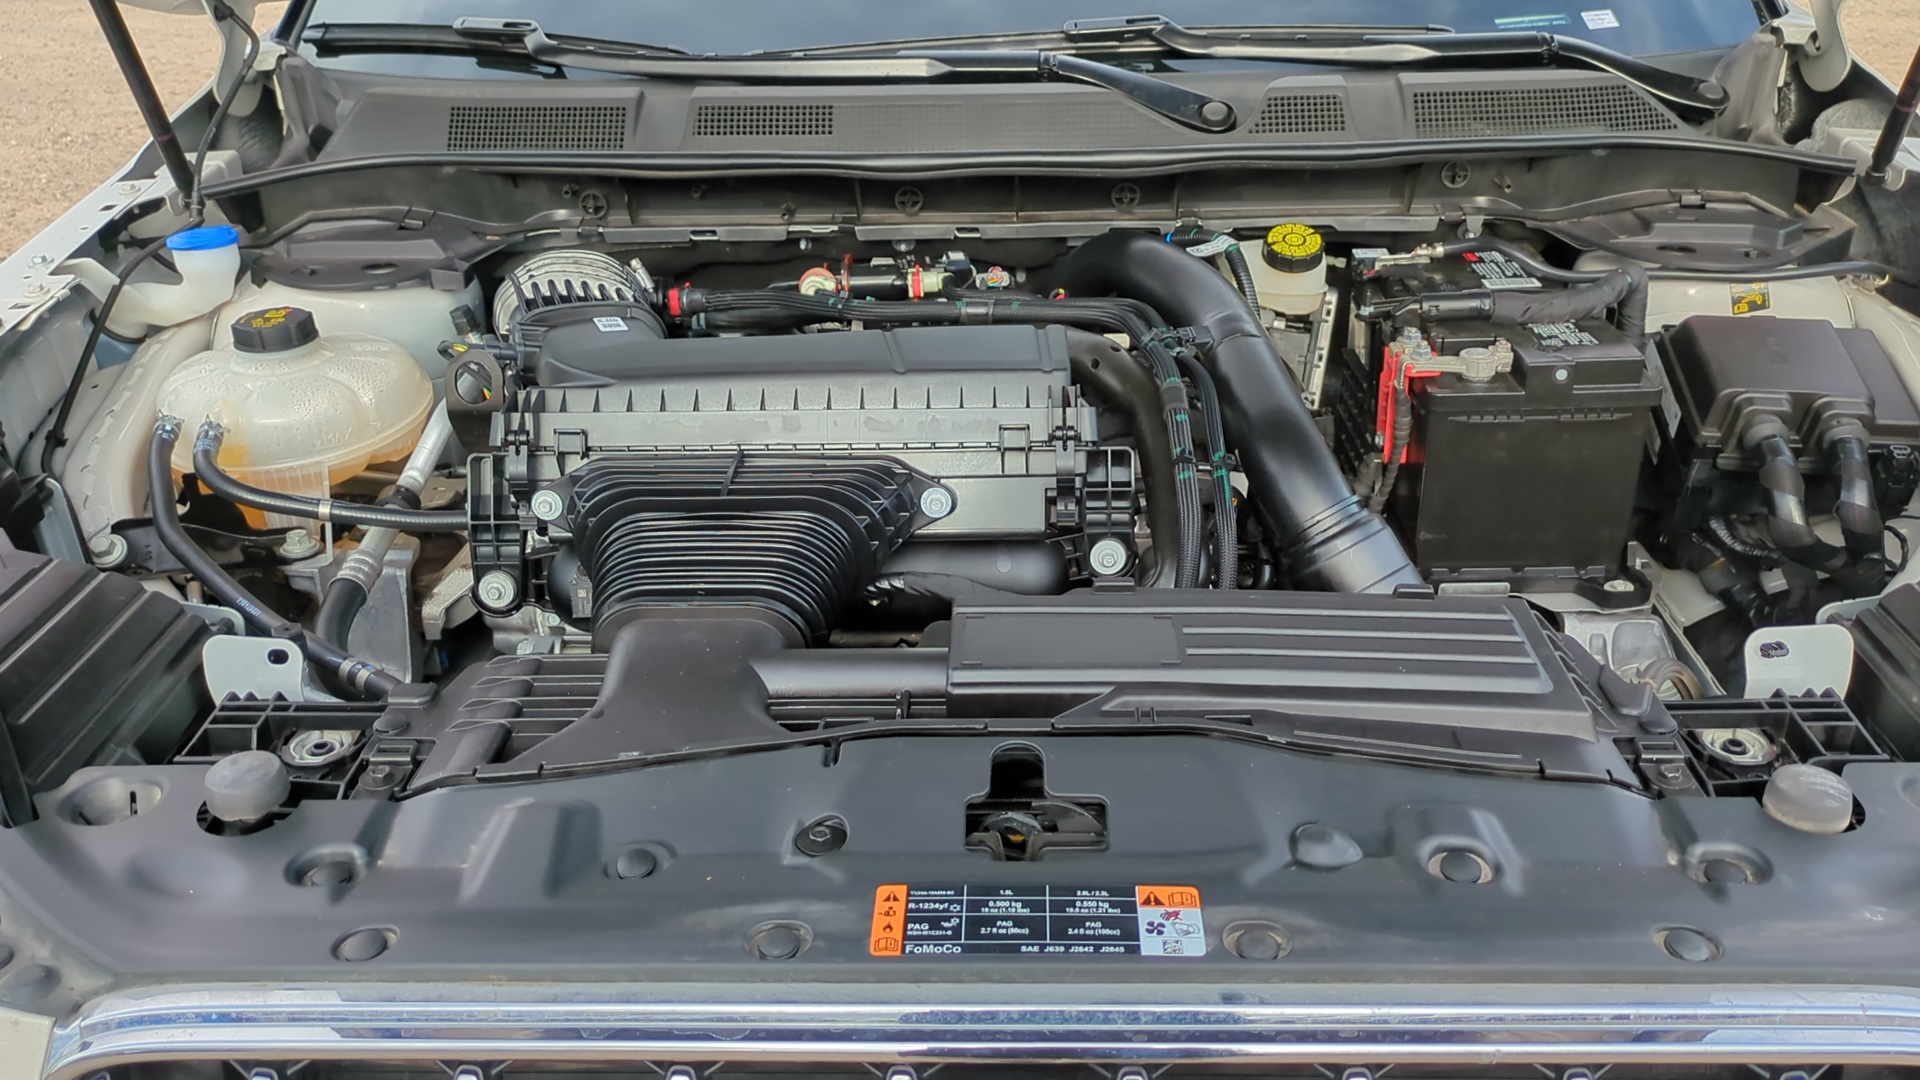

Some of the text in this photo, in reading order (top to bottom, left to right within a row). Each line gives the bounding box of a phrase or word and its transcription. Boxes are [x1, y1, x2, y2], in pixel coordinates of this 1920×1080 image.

[908, 902, 949, 911] R-1234yf
[1011, 900, 1022, 908] kg
[1098, 900, 1109, 908] kg
[905, 944, 962, 954] FoMoCo
[1043, 945, 1066, 953] J639
